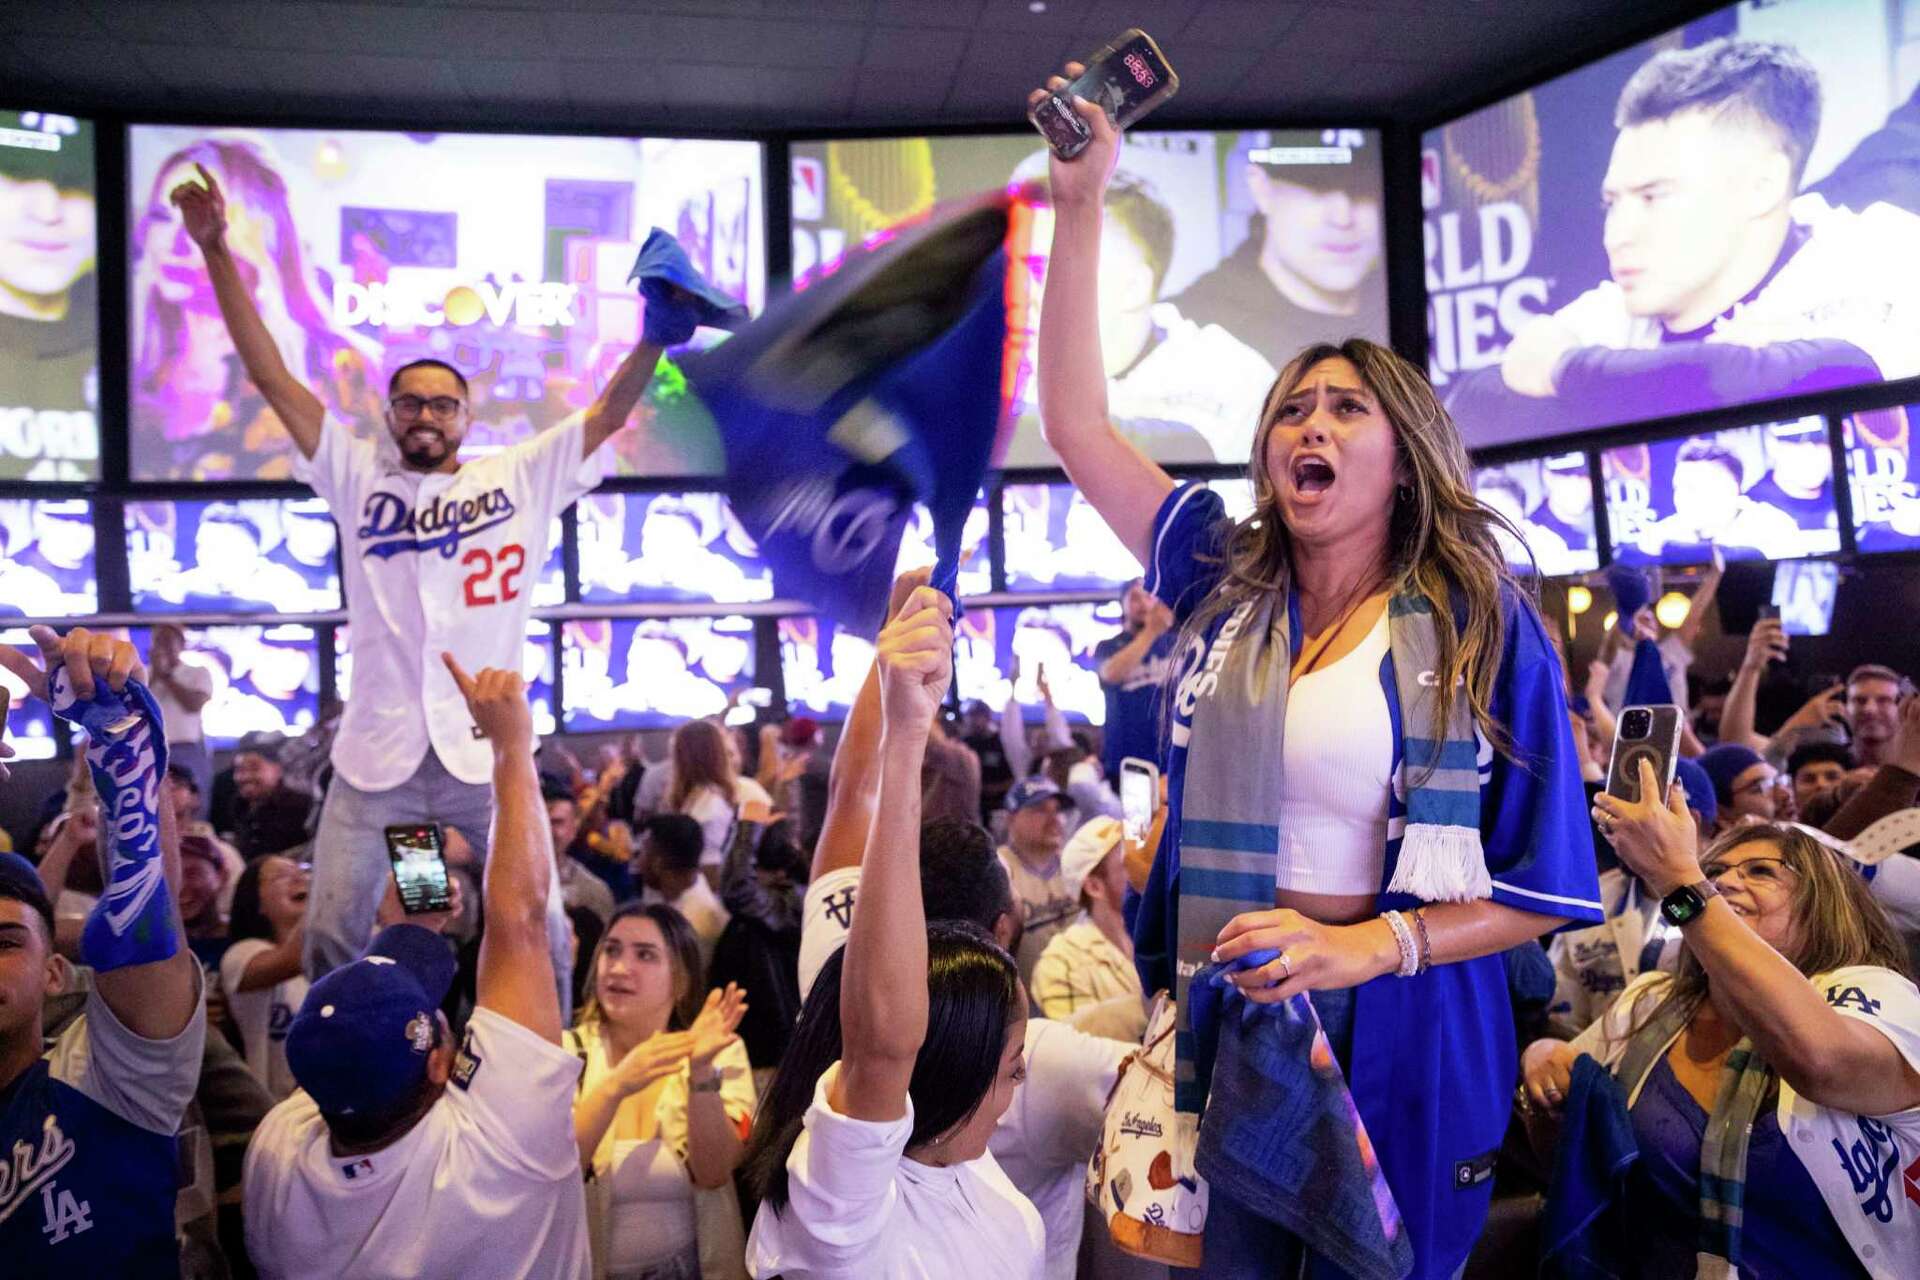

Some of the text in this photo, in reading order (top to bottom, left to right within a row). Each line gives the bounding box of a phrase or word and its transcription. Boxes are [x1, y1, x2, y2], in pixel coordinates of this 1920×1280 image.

[358, 487, 516, 560] Dodgers
[462, 543, 526, 608] 22
[40, 1180, 94, 1246] LA
